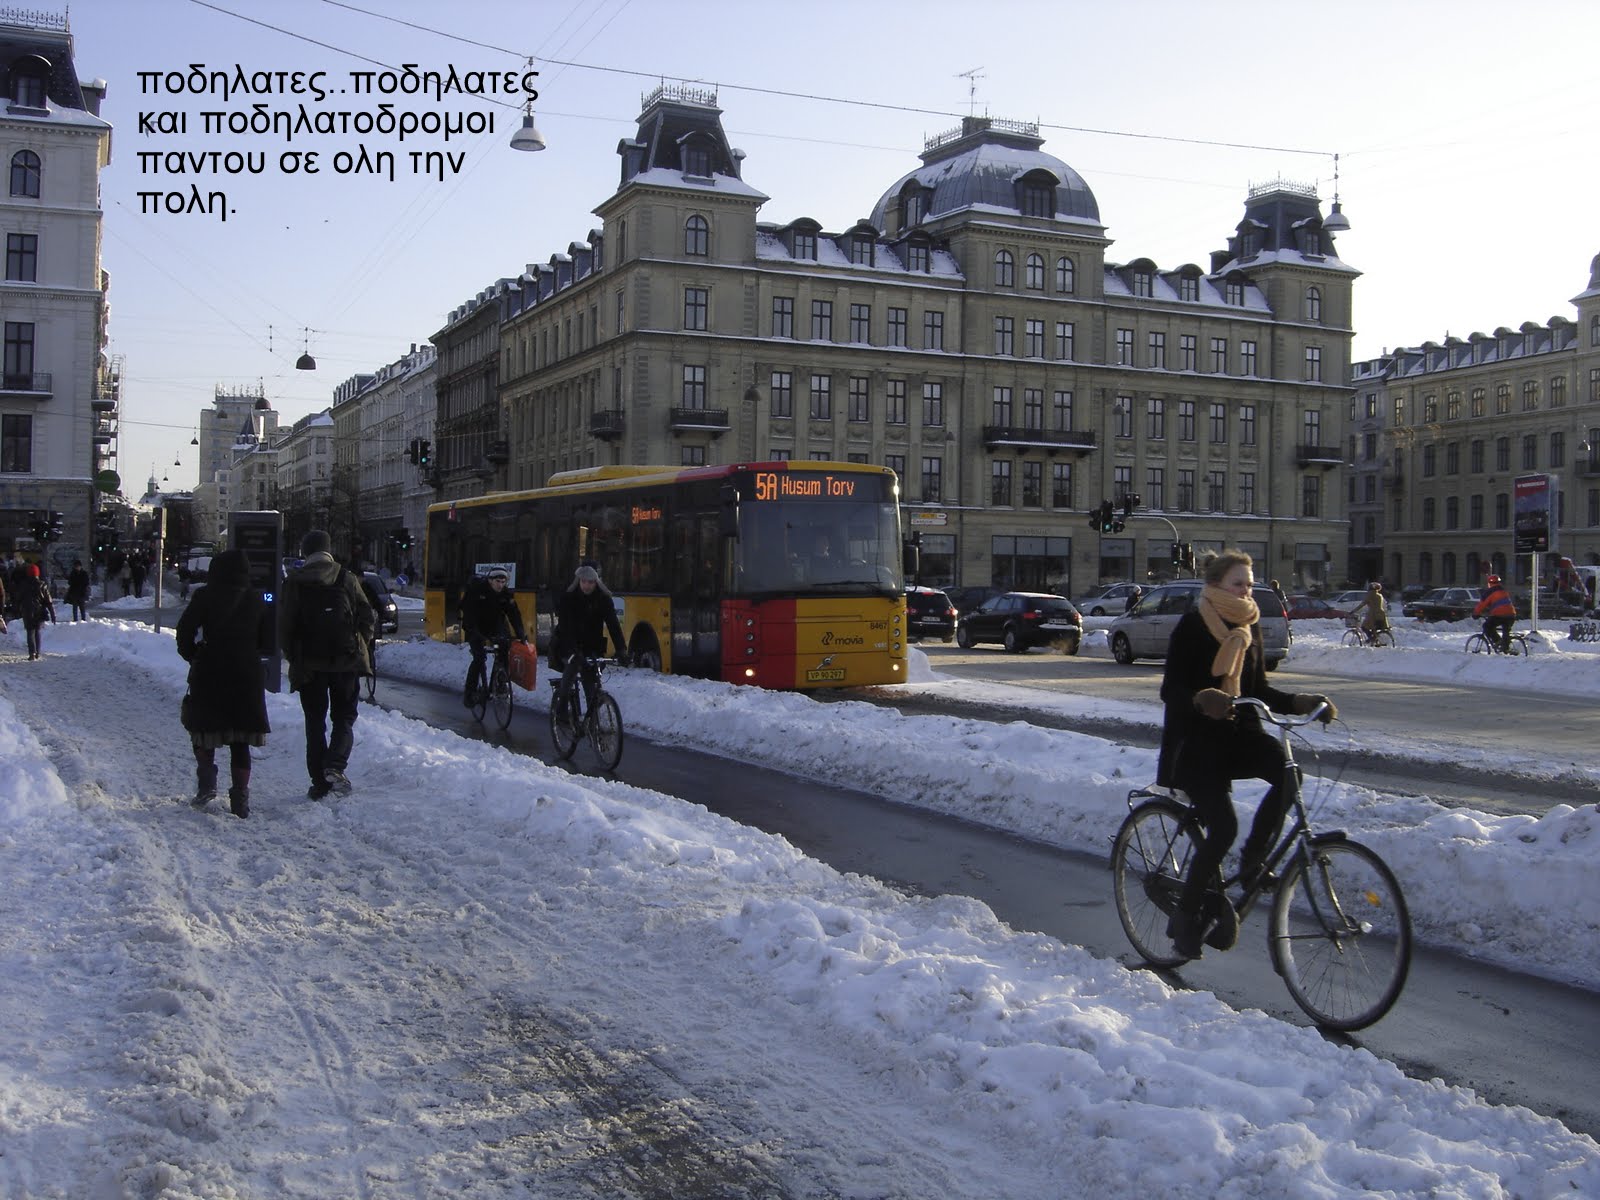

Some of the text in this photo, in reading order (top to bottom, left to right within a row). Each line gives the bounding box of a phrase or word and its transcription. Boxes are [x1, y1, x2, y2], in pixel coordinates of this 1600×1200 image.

[756, 473, 855, 500] 5A Husum Torv
[834, 635, 864, 645] movia
